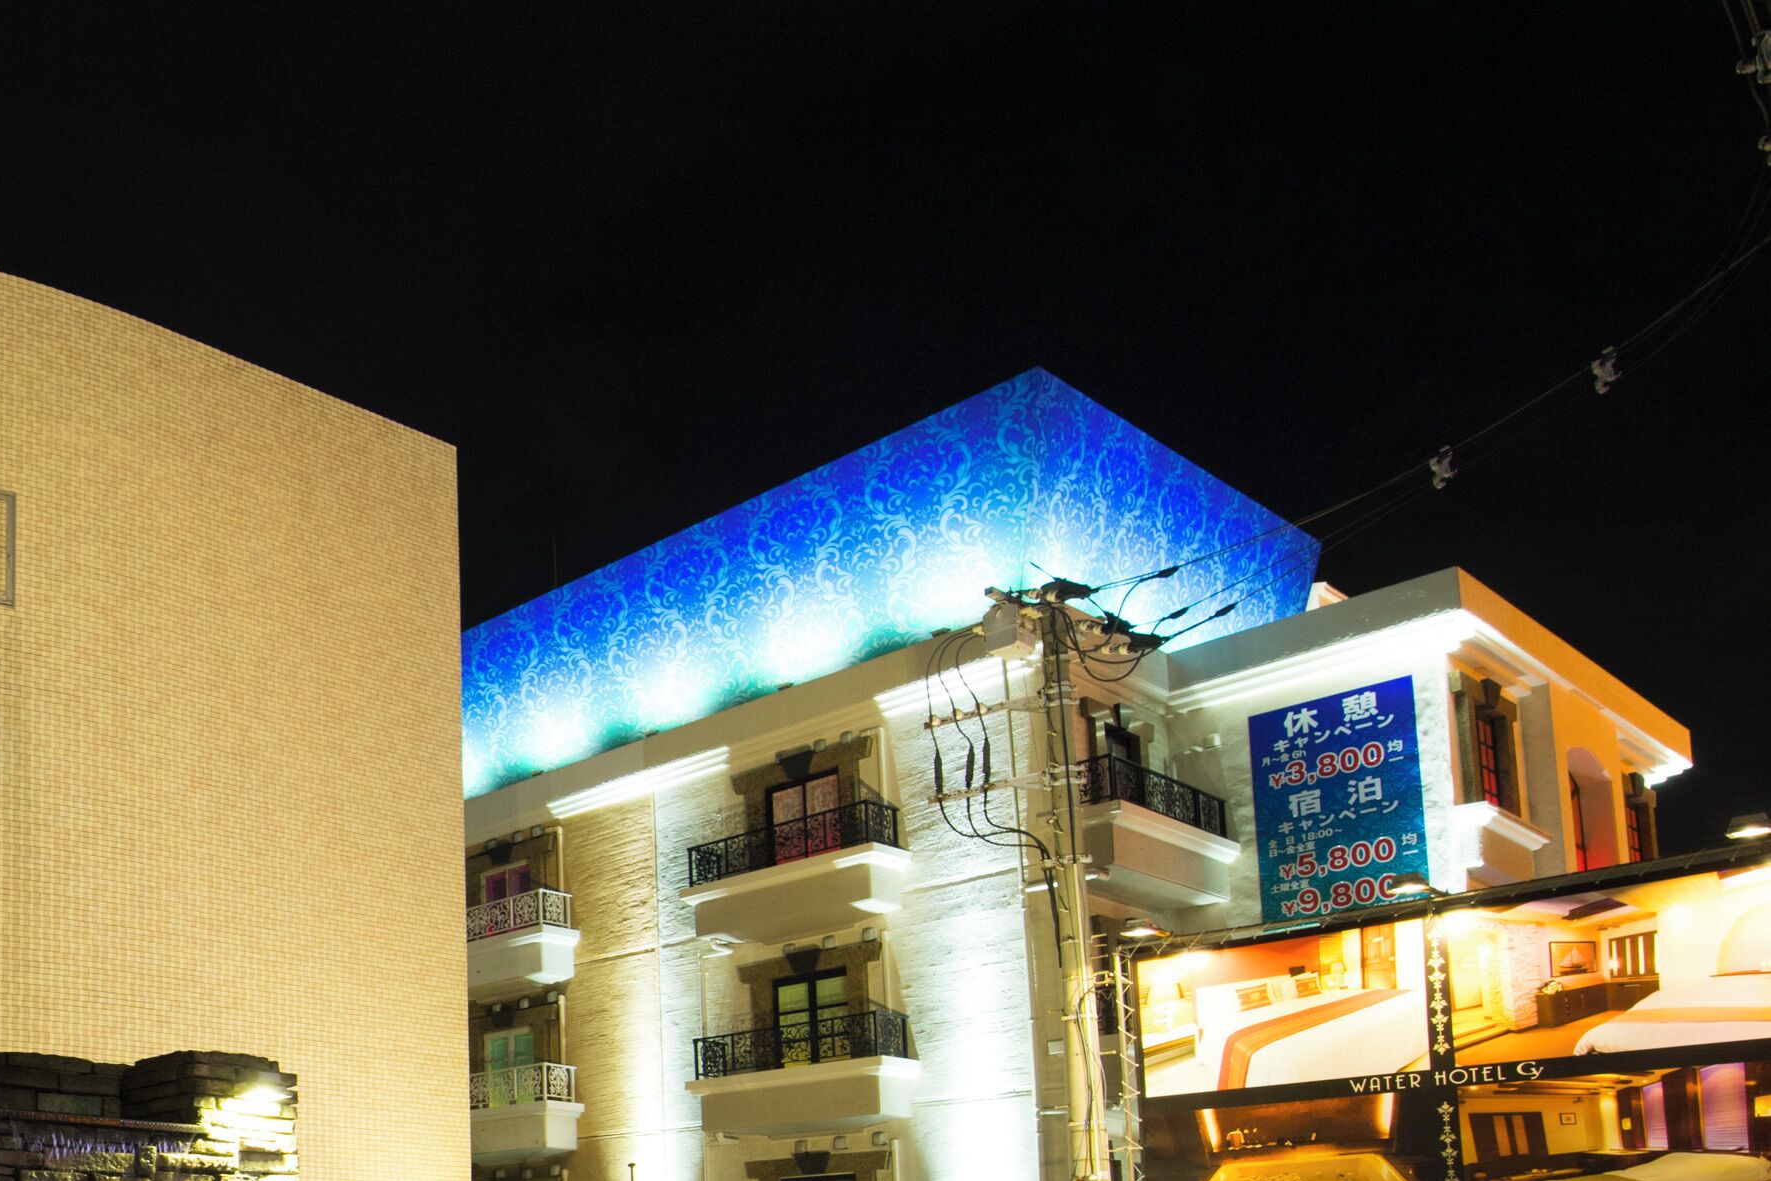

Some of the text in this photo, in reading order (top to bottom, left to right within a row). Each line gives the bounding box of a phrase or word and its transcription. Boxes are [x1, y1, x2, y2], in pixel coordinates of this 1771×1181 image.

[1273, 714, 1394, 752] キャンペーン
[1284, 691, 1378, 737] 休憩
[1288, 776, 1382, 818] 宿泊
[1278, 800, 1399, 834] キャンペーン
[1349, 1061, 1544, 1093] WATER HOTEL Gy
